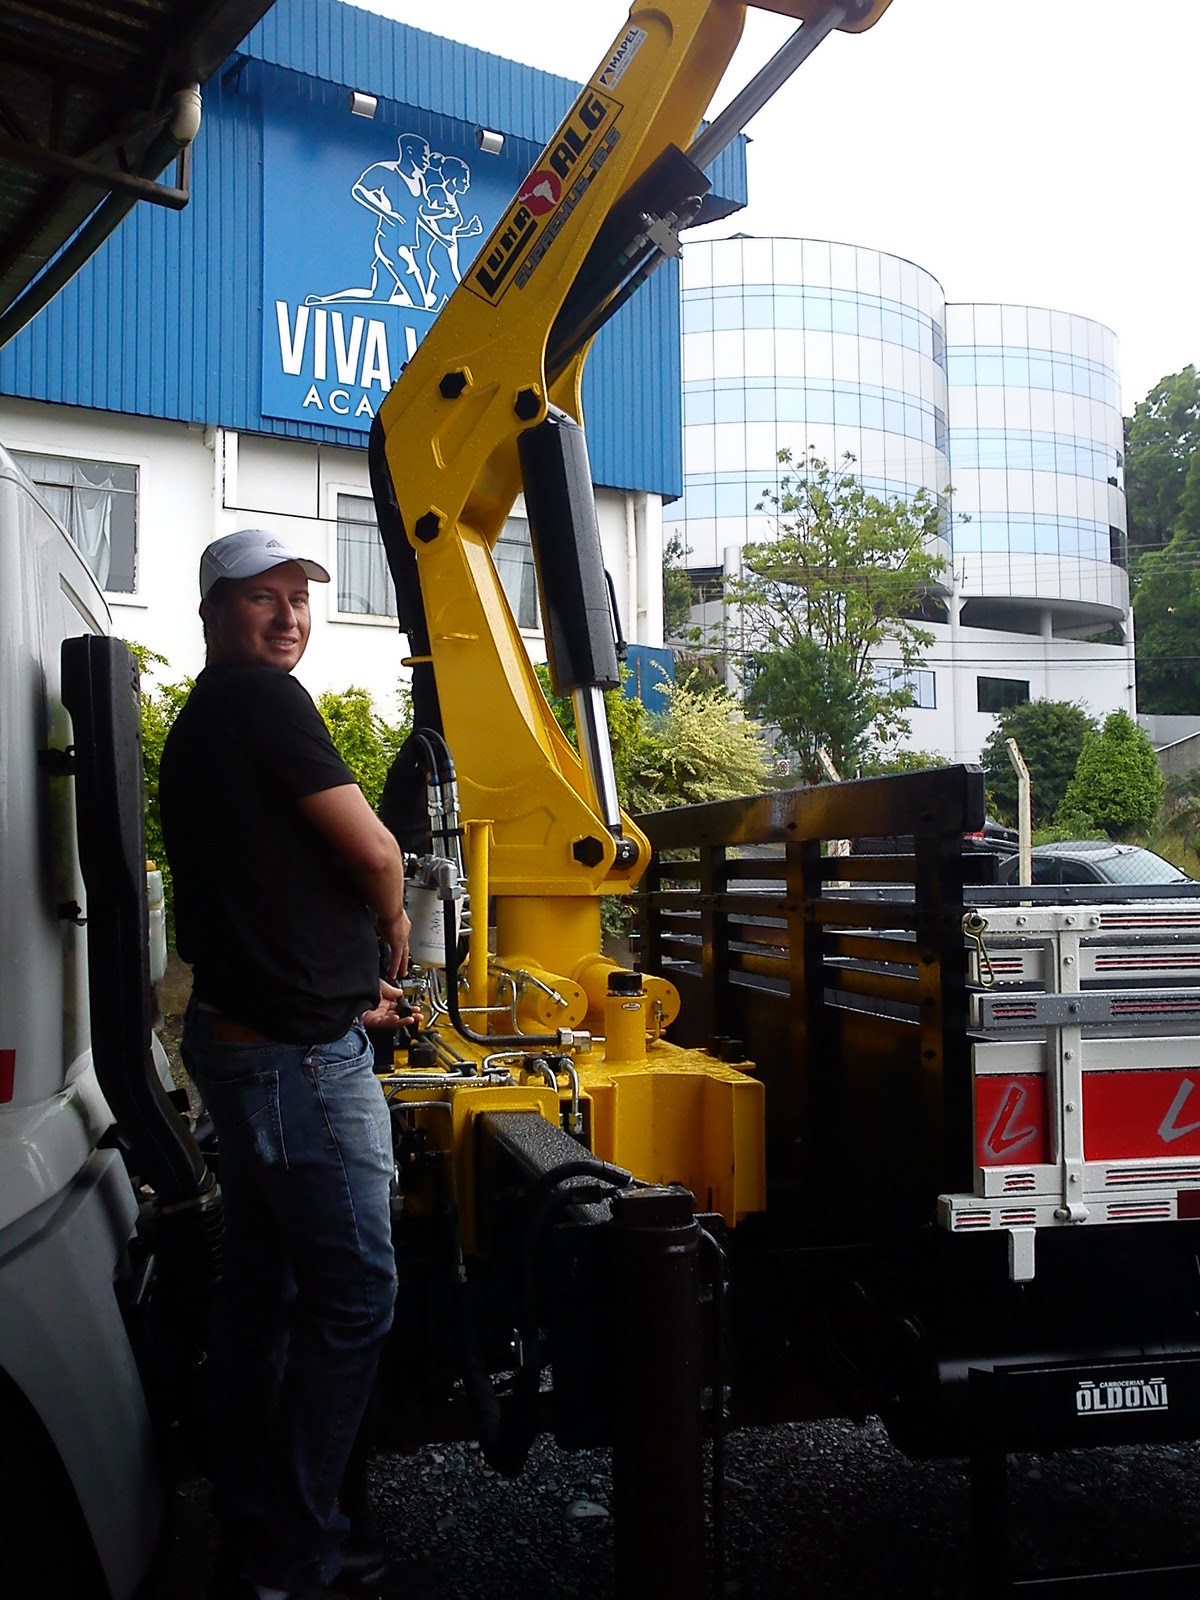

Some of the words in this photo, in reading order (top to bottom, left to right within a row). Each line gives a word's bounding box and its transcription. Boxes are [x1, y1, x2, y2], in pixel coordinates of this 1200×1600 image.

[609, 29, 639, 68] MAPEL
[476, 206, 537, 298] LUNA
[550, 93, 607, 180] ALG
[515, 176, 590, 290] SUPREMUS
[275, 300, 392, 392] VIVA
[302, 384, 384, 419] ACA
[1076, 1384, 1168, 1410] OLDONI
[1100, 1380, 1144, 1388] CARROCERIAS
